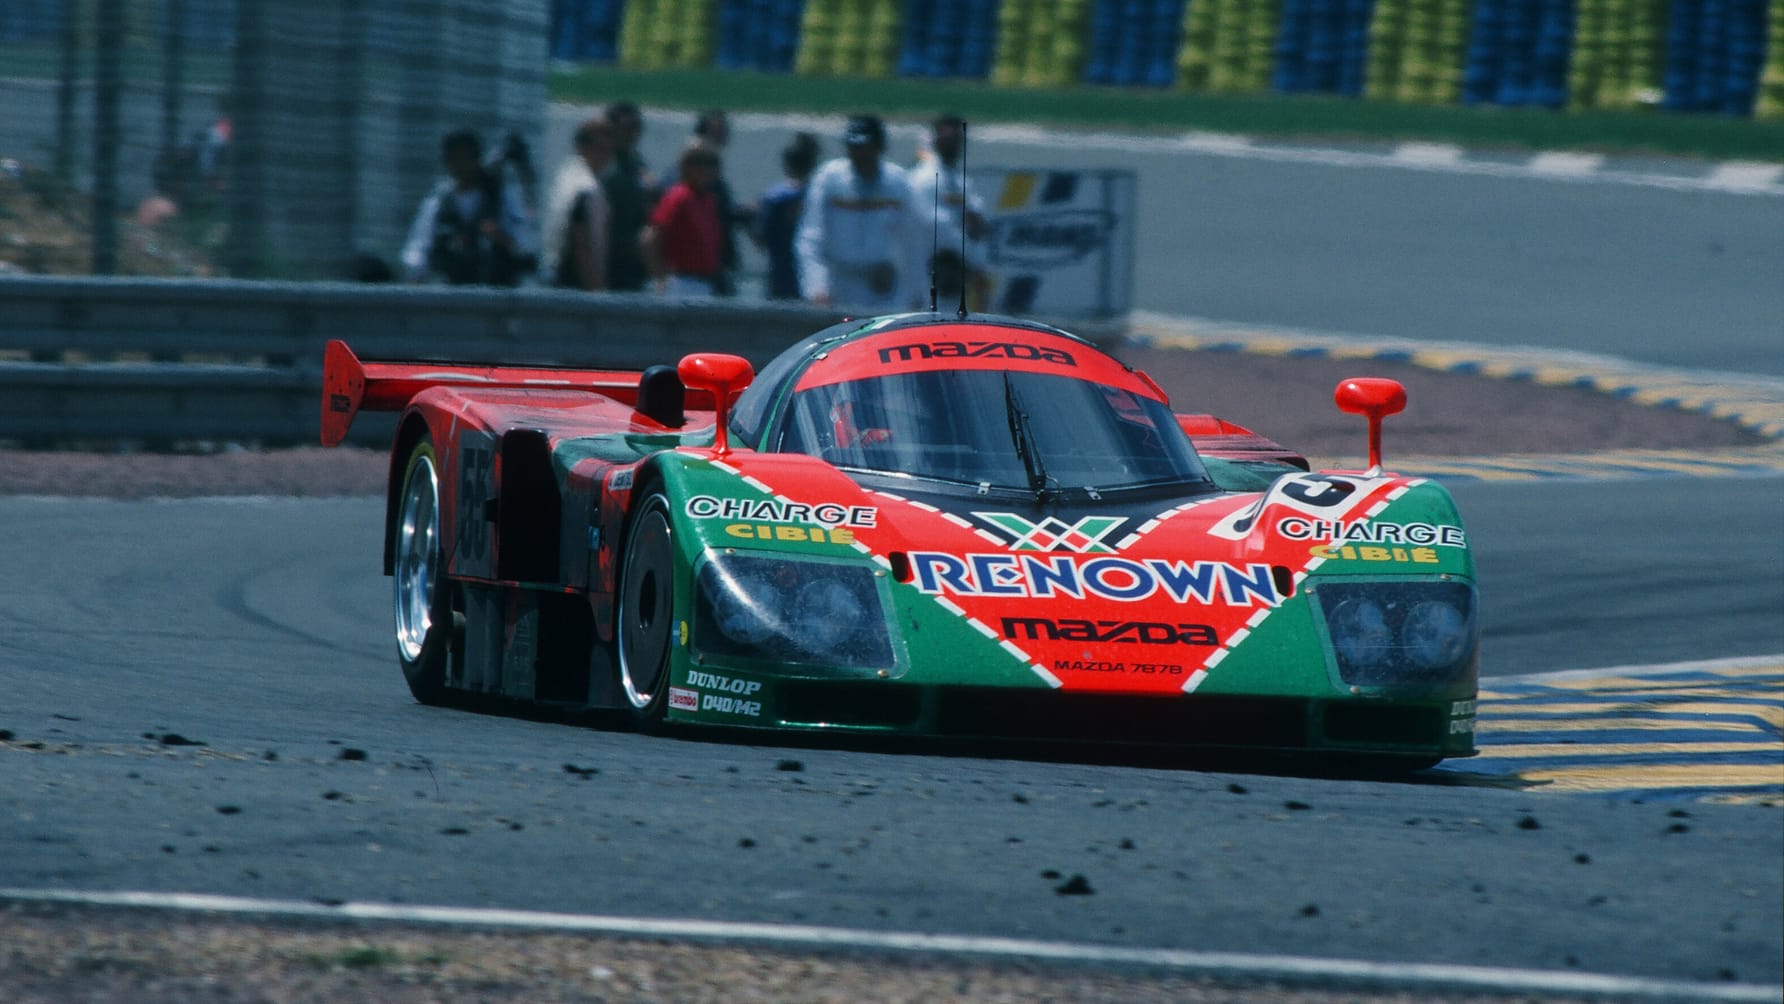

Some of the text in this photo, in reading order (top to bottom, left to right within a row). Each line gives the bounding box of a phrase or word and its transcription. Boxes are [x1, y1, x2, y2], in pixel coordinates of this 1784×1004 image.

[685, 495, 878, 529] CHARGE
[1277, 517, 1467, 548] CHARGE
[907, 551, 1282, 607] RENOWN
[686, 669, 762, 695] DUNLOP
[1054, 660, 1183, 675] MAZDA 787B
